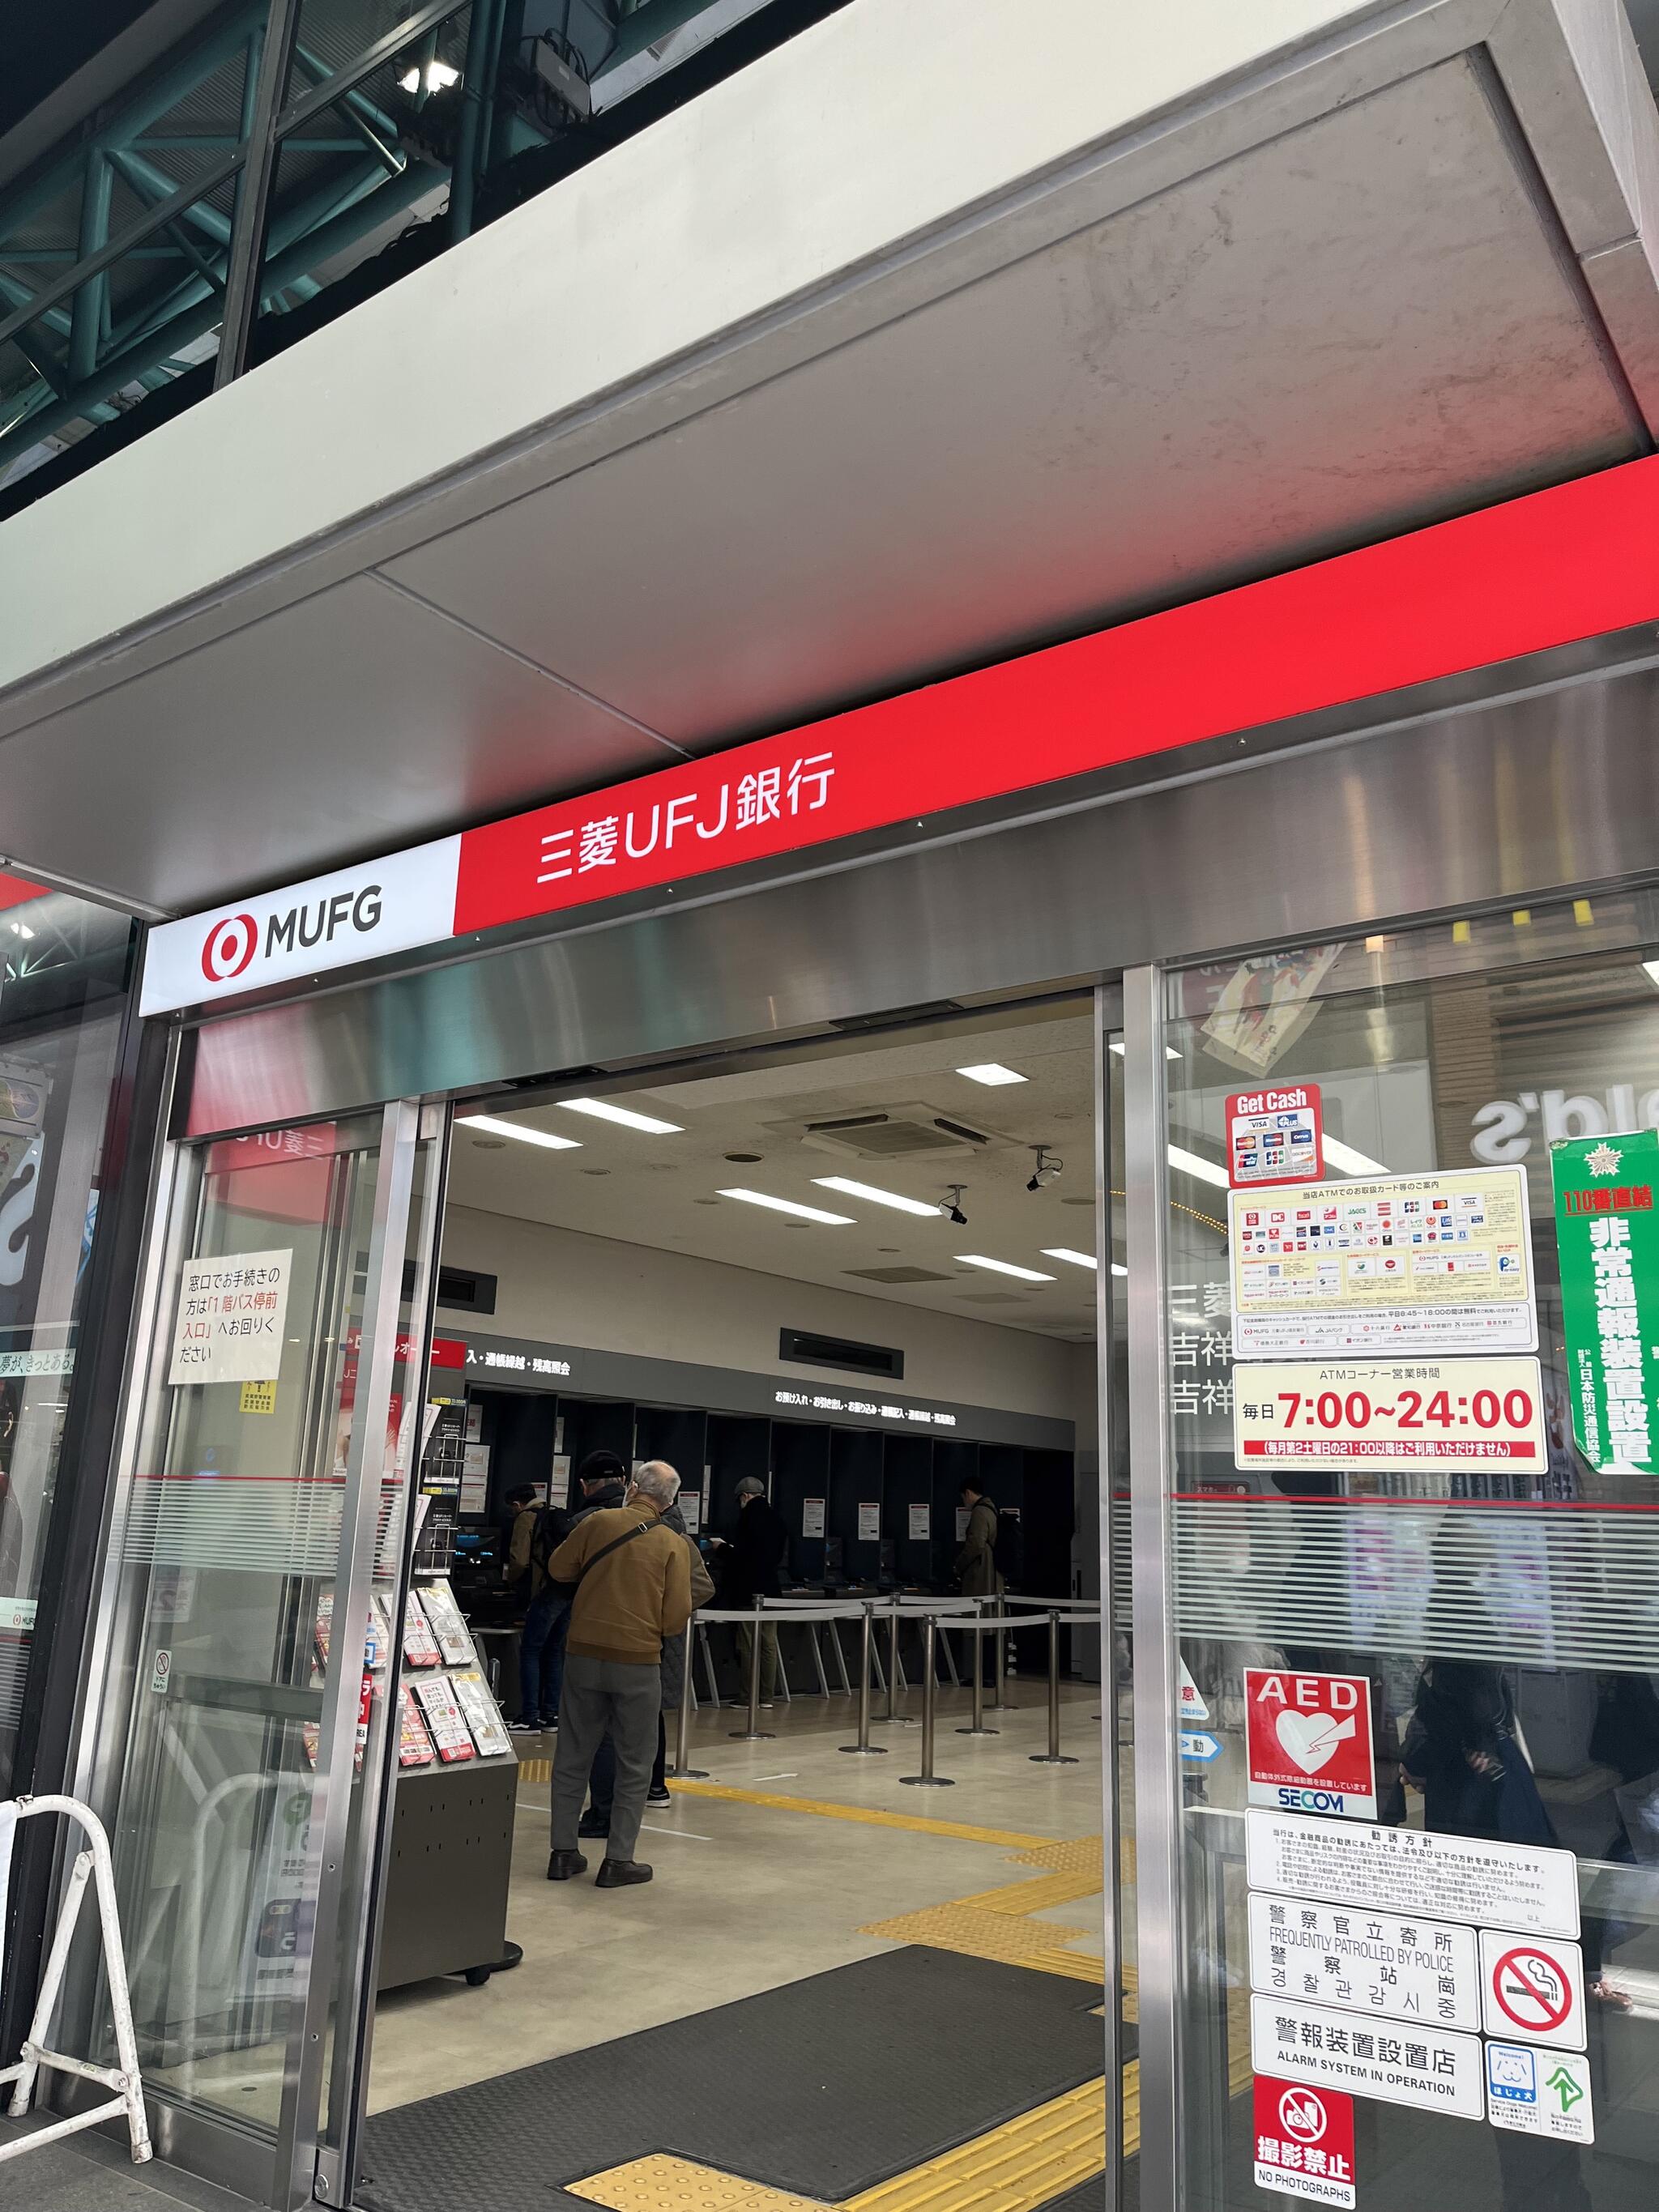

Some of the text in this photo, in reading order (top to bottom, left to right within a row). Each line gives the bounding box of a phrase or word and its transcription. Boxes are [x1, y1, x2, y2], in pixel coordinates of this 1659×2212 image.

[536, 752, 835, 884] 三菱UFJ銀行
[265, 885, 382, 957] MUFG
[1237, 1089, 1307, 1115] Get Cash
[1266, 1150, 1284, 1165] JCB
[1303, 1181, 1439, 1200] 当店ATMでのお取扱カード等のご案内
[1563, 1185, 1653, 1213] 110番直結
[189, 1268, 279, 1292] 窓口でお手続きの
[1589, 1217, 1652, 1463] 非常通報装置設置
[180, 1347, 211, 1363] ださい
[1320, 1367, 1440, 1380] ATMコーナー営業時間
[1243, 1403, 1273, 1421] 毎日
[1580, 1369, 1601, 1463] 日本防災通信協会
[1182, 1686, 1195, 1701] 意
[1256, 1677, 1358, 1711] AED
[1192, 1739, 1204, 1753] 動
[1255, 1771, 1367, 1792] 自動体外式除細動器を設置しています
[1278, 1788, 1344, 1813] SECOM
[1371, 1830, 1432, 1848] 勧誘方針
[1269, 1905, 1452, 1953] 警察官立寄所
[1528, 1914, 1540, 1923] 以上
[1270, 1926, 1453, 1973] FREQUENTLY PATROLLED BY POLICE
[1275, 2016, 1455, 2076] 警報装置設置店
[1277, 2051, 1455, 2096] ALARM SYSTEM IN OPERATION
[1494, 2087, 1533, 2100] ほじょ犬
[1257, 2136, 1350, 2181] 撮影禁止
[1259, 2170, 1350, 2202] NO PHOTOGRAPHS
